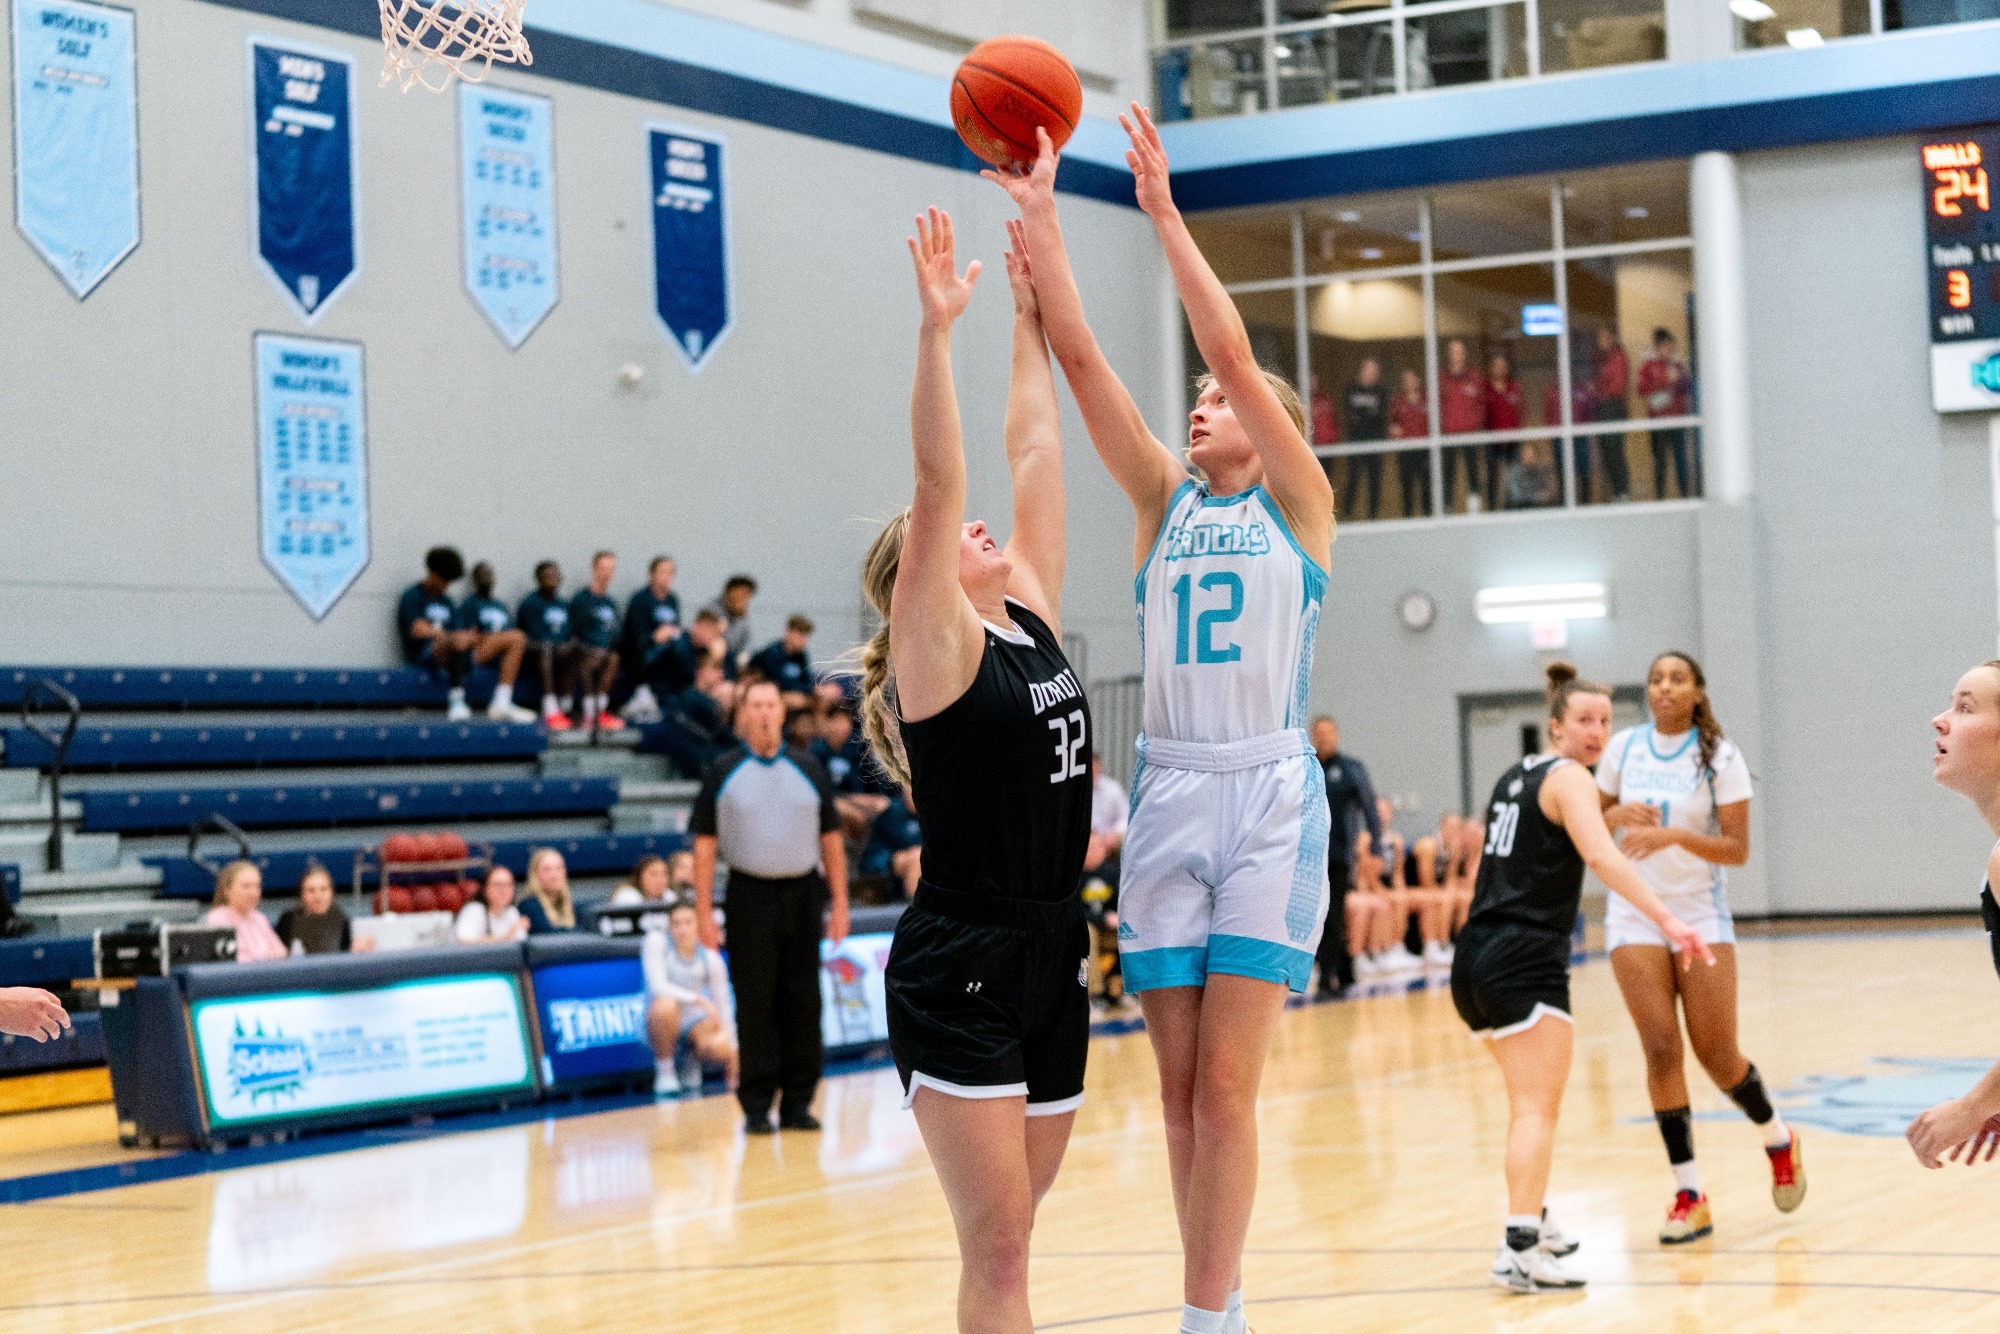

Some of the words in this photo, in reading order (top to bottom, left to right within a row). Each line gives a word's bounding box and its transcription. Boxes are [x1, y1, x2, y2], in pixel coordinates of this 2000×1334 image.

[1933, 166, 1991, 217] 24
[1946, 268, 1972, 309] 3
[1172, 571, 1245, 665] 12
[1047, 708, 1087, 784] 32
[1484, 801, 1520, 857] 30
[1645, 796, 1671, 827] 1
[548, 993, 647, 1053] TRINIT
